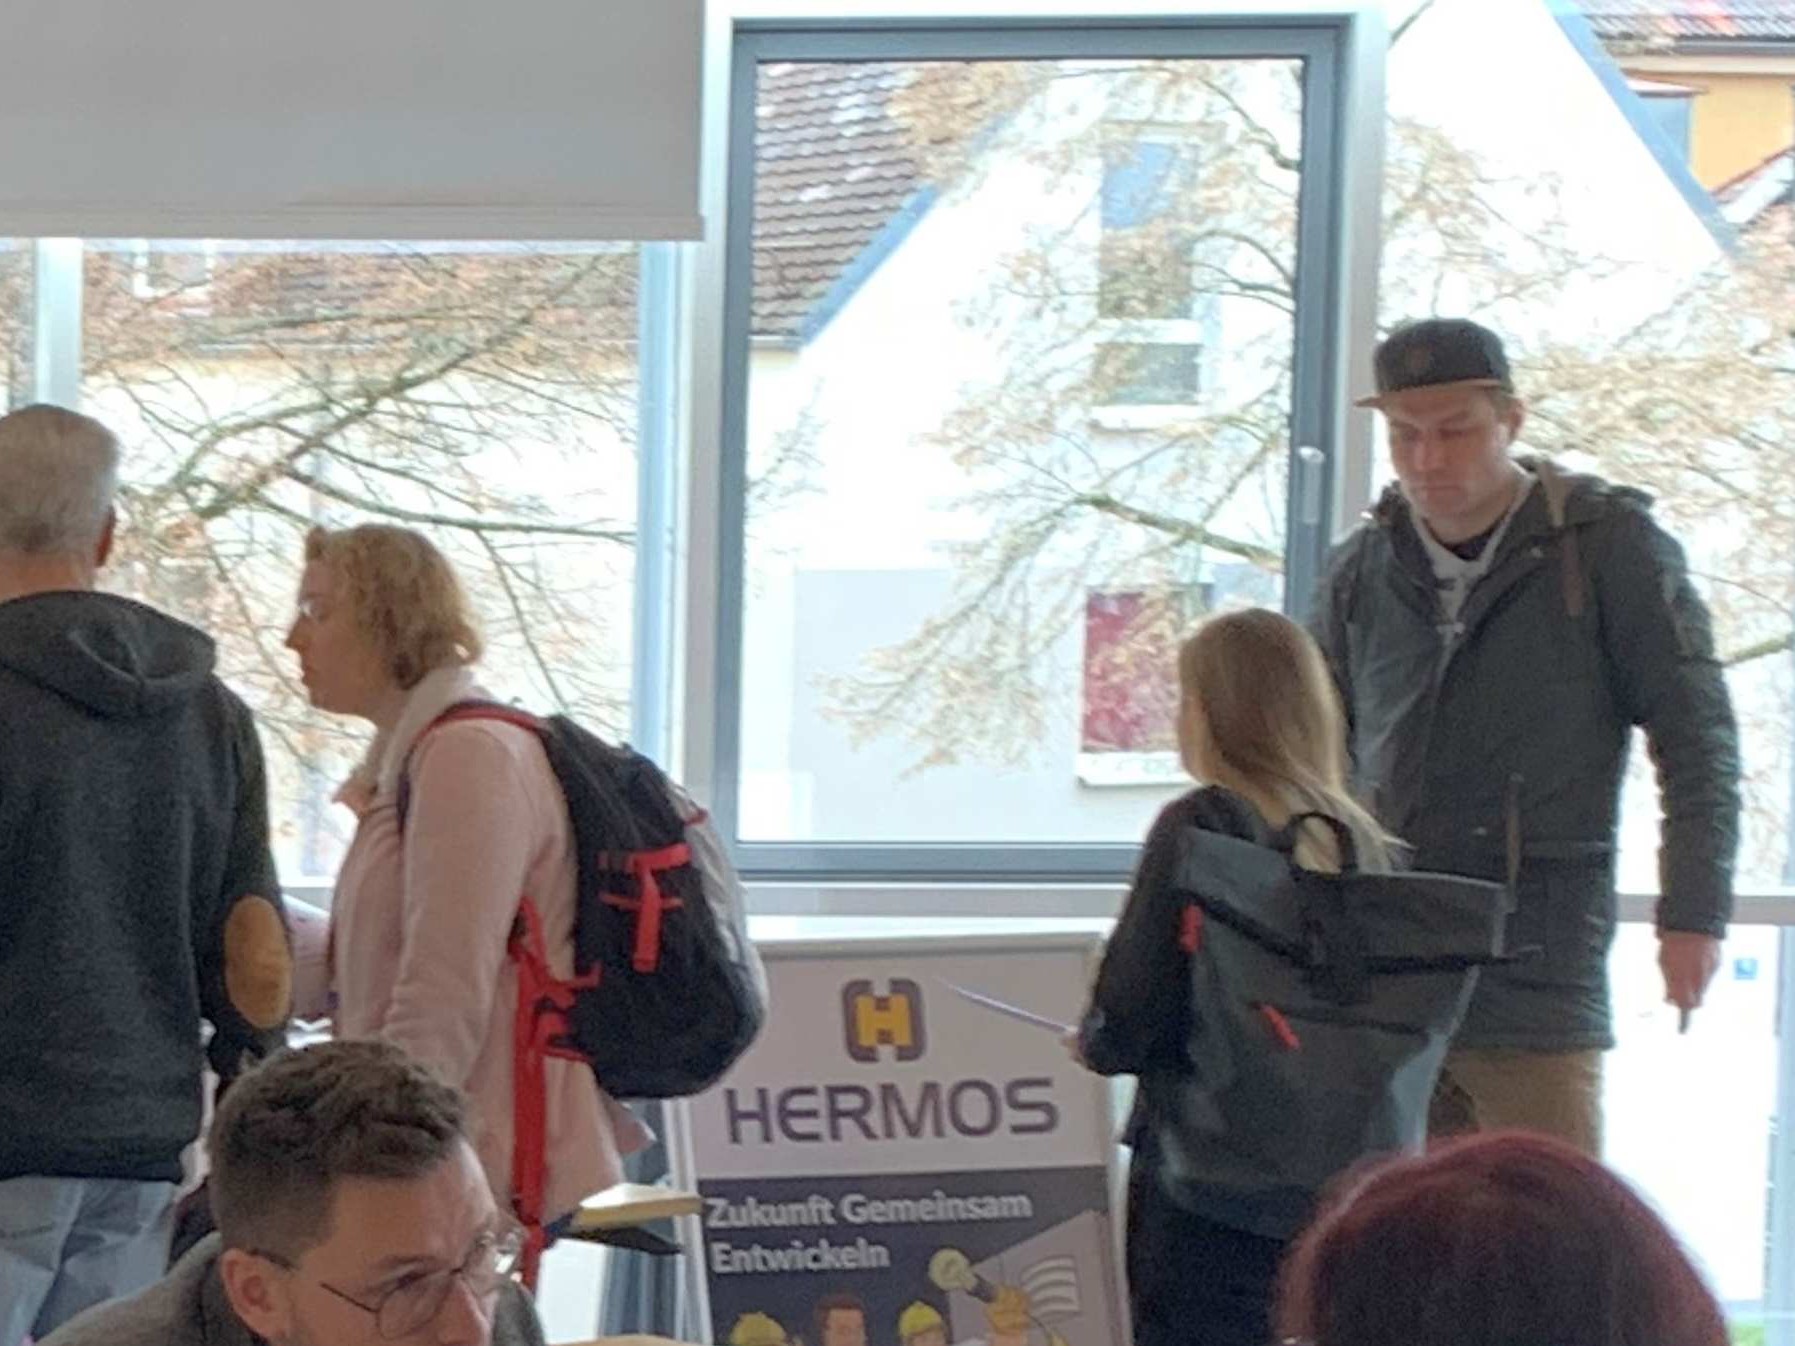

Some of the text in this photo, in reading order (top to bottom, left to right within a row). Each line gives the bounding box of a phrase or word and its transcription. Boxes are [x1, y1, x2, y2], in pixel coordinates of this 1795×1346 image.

[722, 1076, 1059, 1144] HERMOS
[706, 1190, 1033, 1230] Zukunft Gemeinsam
[710, 1240, 890, 1275] Entwickeln
